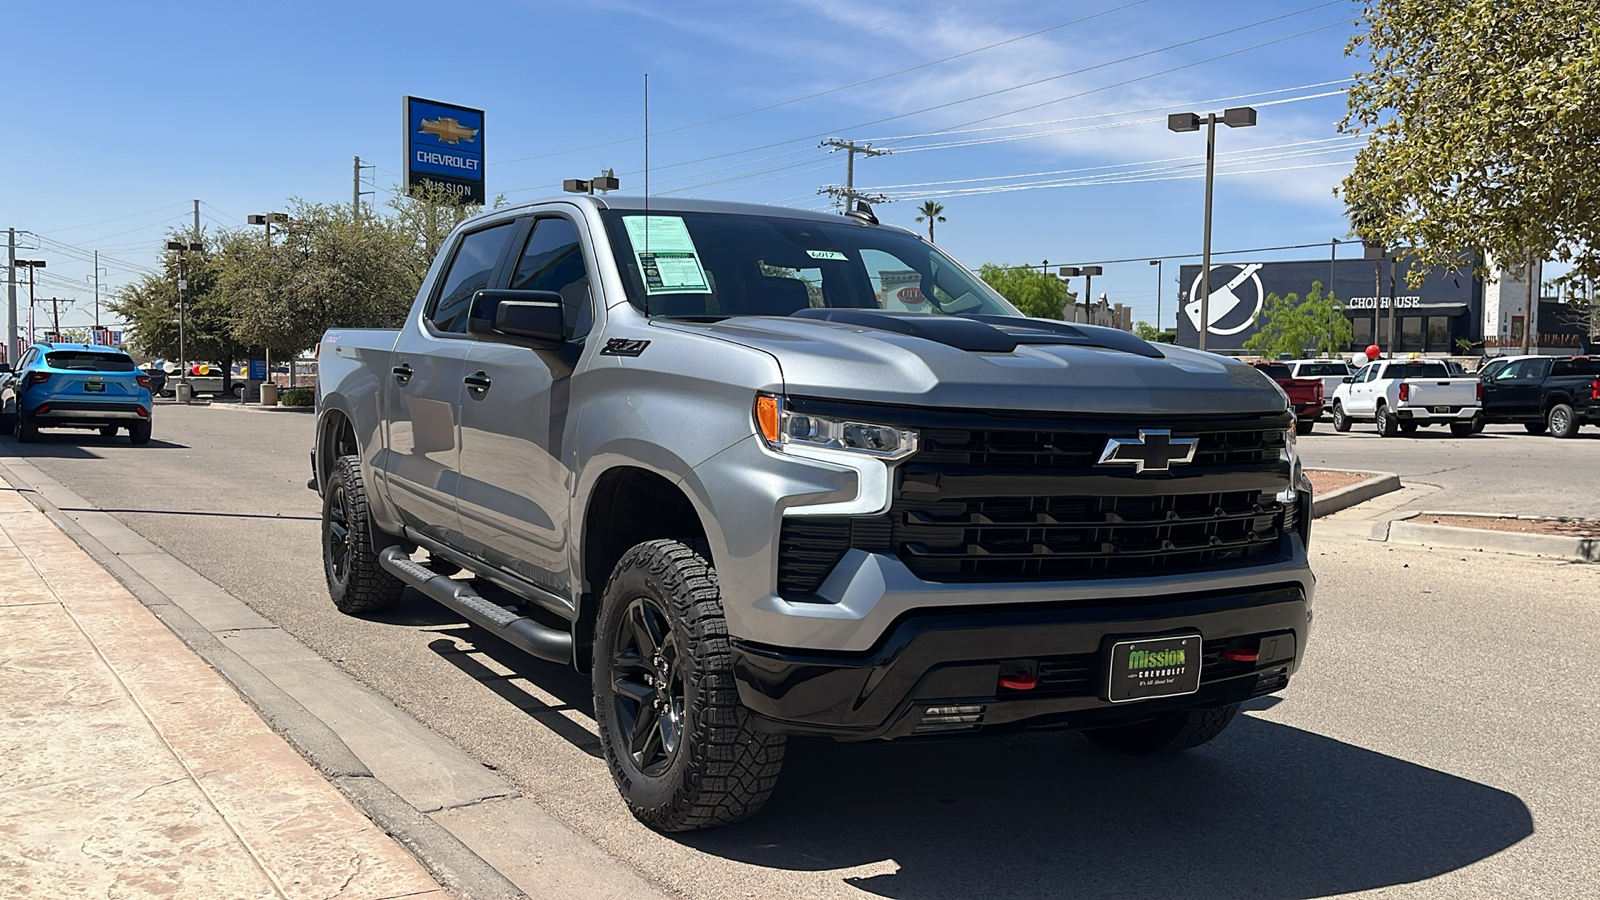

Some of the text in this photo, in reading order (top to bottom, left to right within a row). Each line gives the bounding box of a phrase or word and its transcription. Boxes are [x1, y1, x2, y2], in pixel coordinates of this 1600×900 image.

[416, 151, 479, 170] CHEVROLET
[425, 180, 471, 196] MISSION
[901, 290, 922, 299] ULT
[1128, 648, 1186, 670] Mission
[1138, 667, 1186, 678] CHEVROLET
